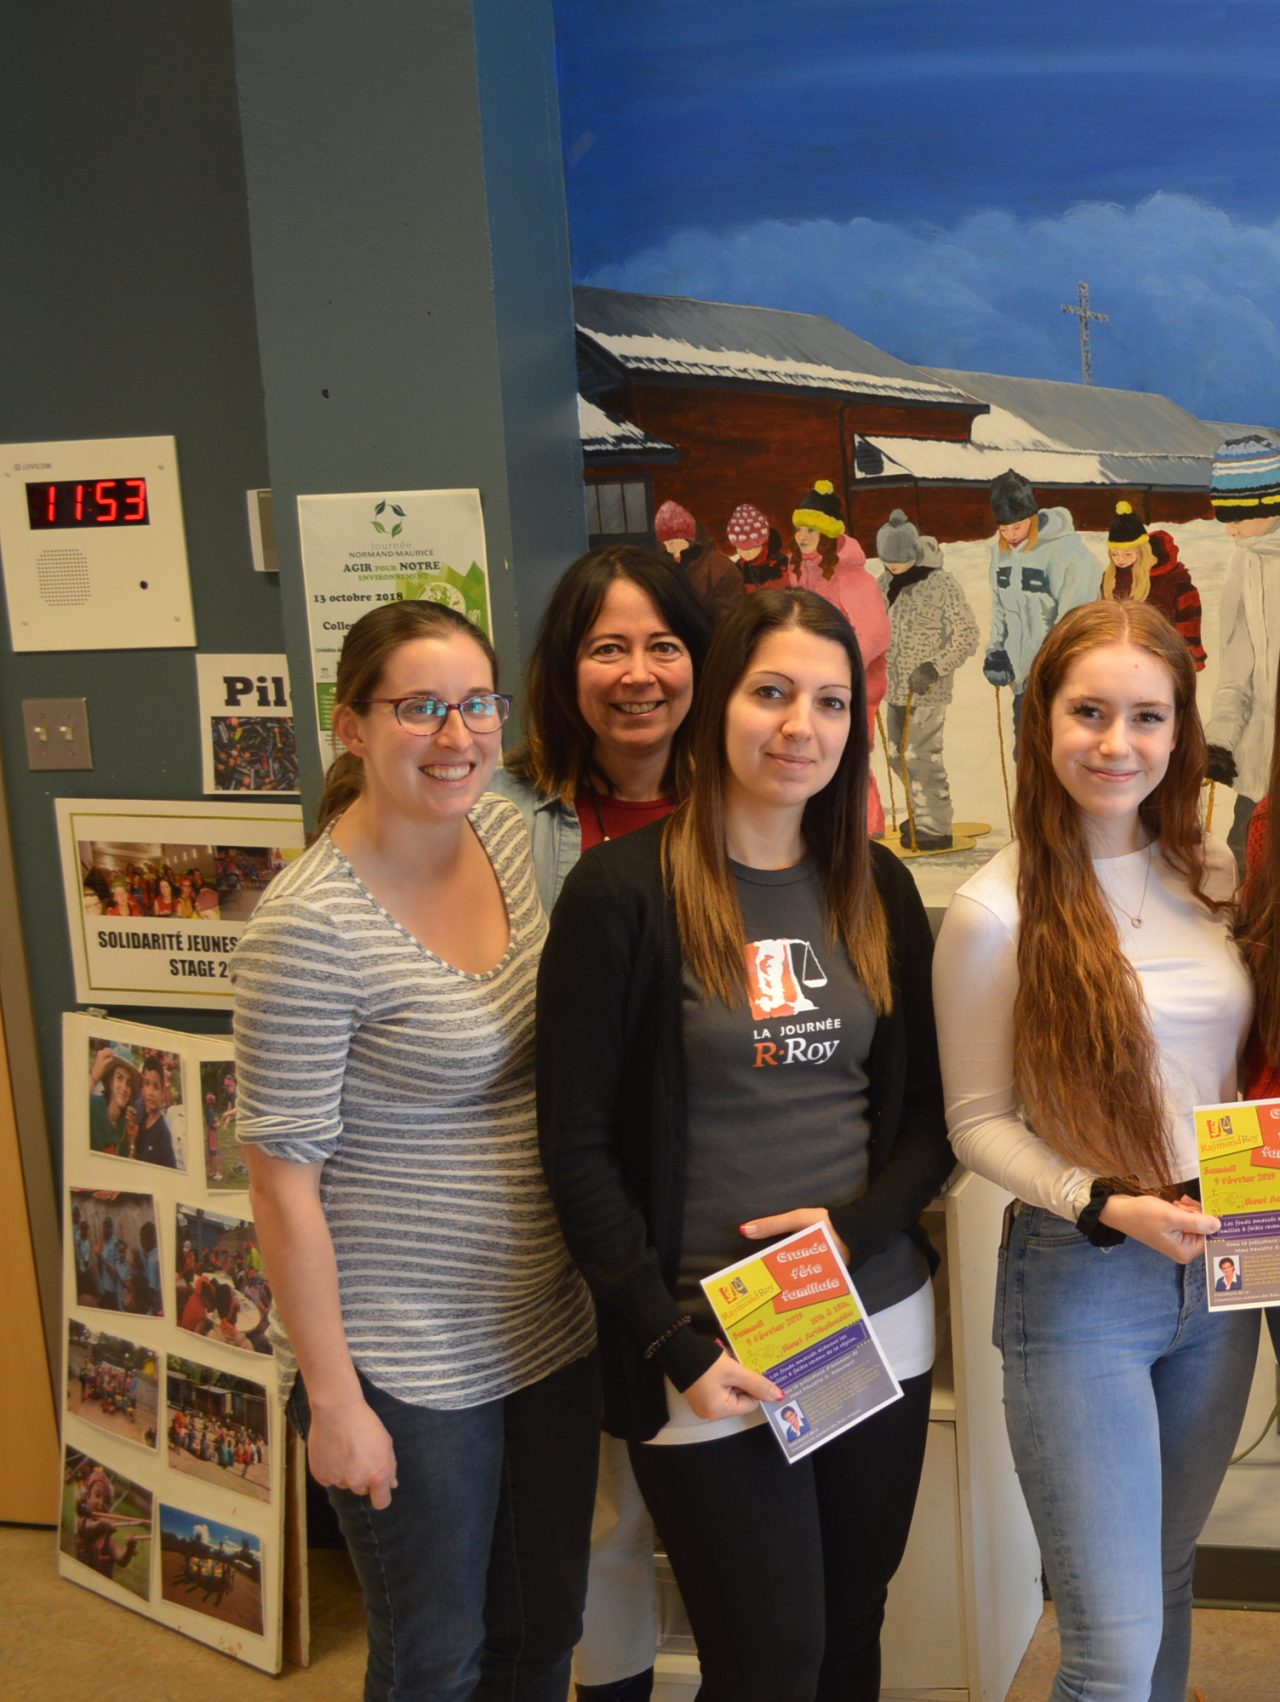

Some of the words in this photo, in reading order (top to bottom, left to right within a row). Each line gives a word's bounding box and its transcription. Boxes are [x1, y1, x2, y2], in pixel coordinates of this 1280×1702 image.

[344, 563, 372, 573] AGIR
[399, 561, 441, 571] NOTRE
[358, 573, 428, 581] ENVIRONNEMENT
[314, 595, 326, 603] 13
[329, 592, 372, 602] octobre
[376, 592, 403, 601] 2018
[223, 675, 292, 707] Pil
[98, 930, 184, 951] SOLIDARITÉ
[169, 959, 216, 977] STAGE
[753, 1029, 771, 1040] LA
[780, 1018, 842, 1037] JOURNÉE
[777, 1241, 828, 1263] Grande
[791, 1263, 823, 1279] fête
